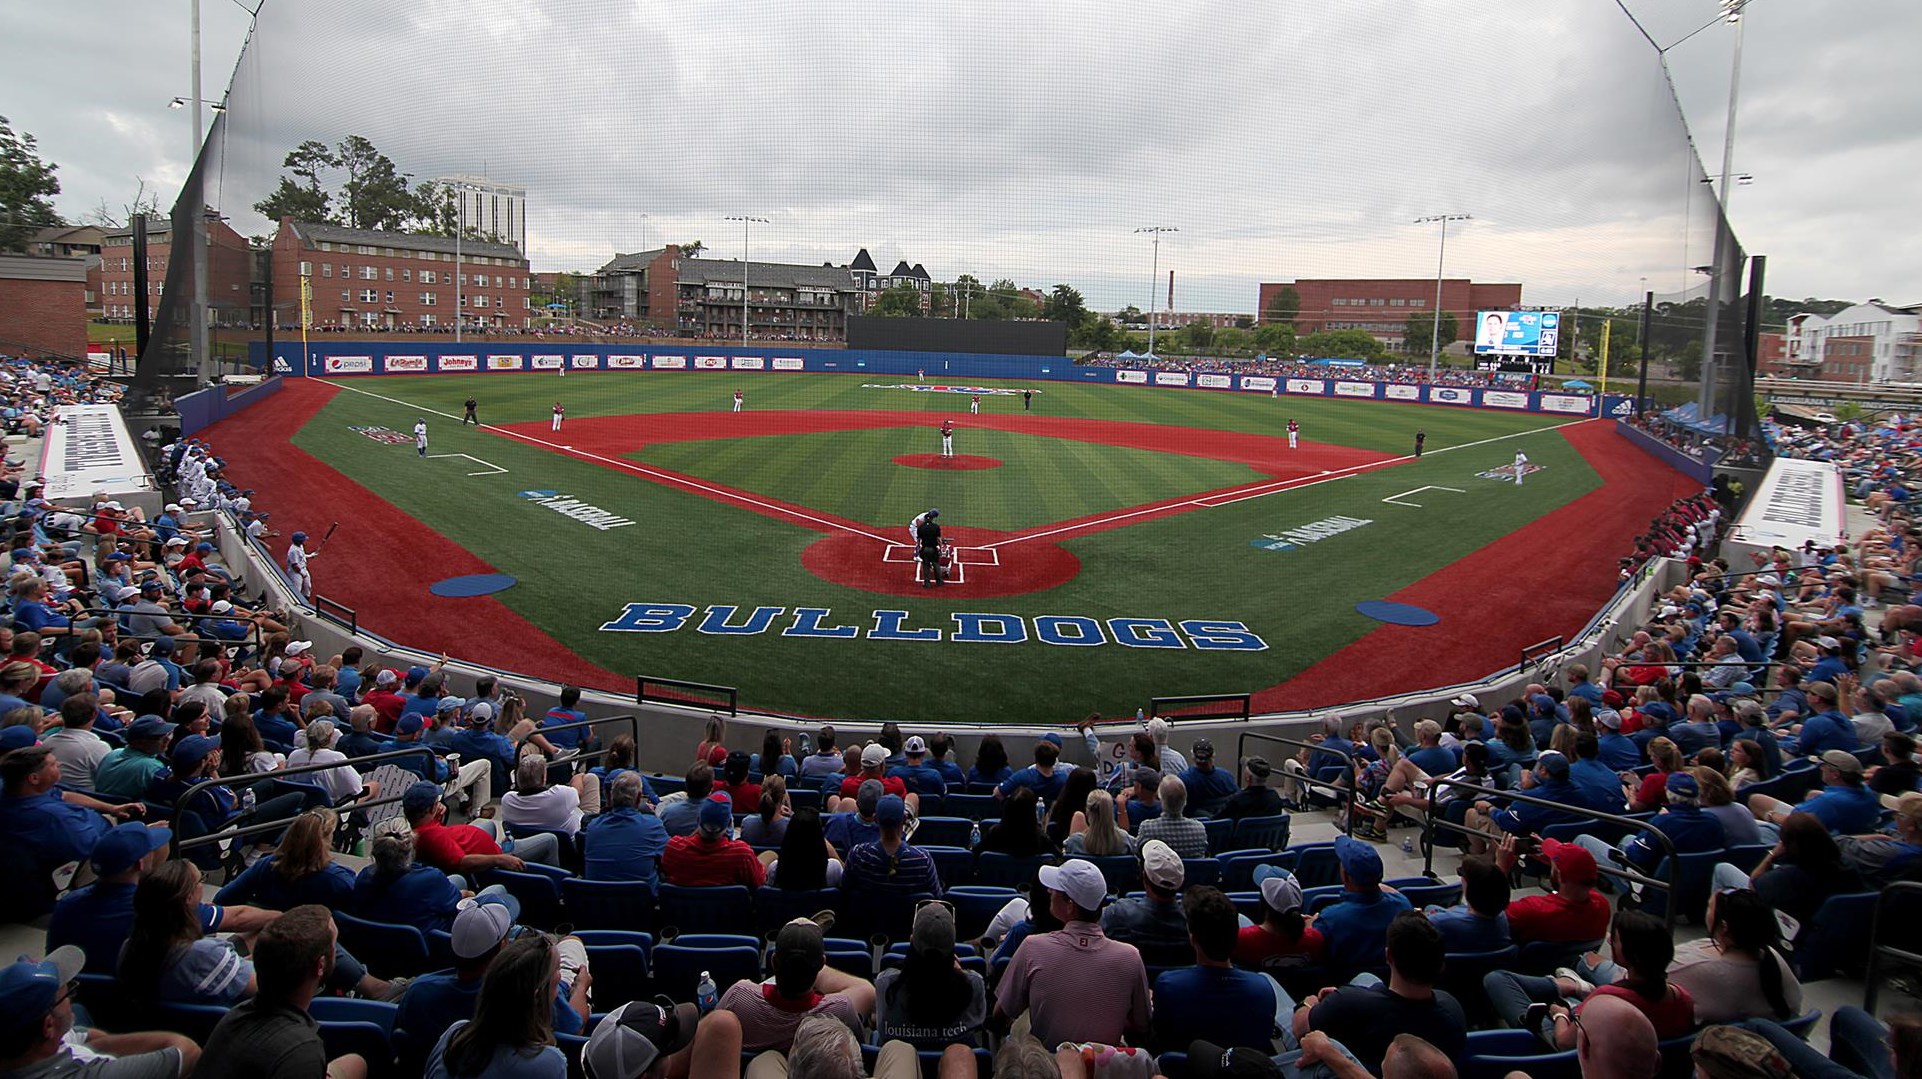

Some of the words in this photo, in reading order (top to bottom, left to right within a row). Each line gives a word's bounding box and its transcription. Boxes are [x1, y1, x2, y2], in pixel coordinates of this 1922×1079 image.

[343, 360, 367, 368] pepsi
[599, 602, 1269, 651] BULLDOGS
[884, 1020, 938, 1037] louisiana
[942, 1021, 968, 1037] tech
